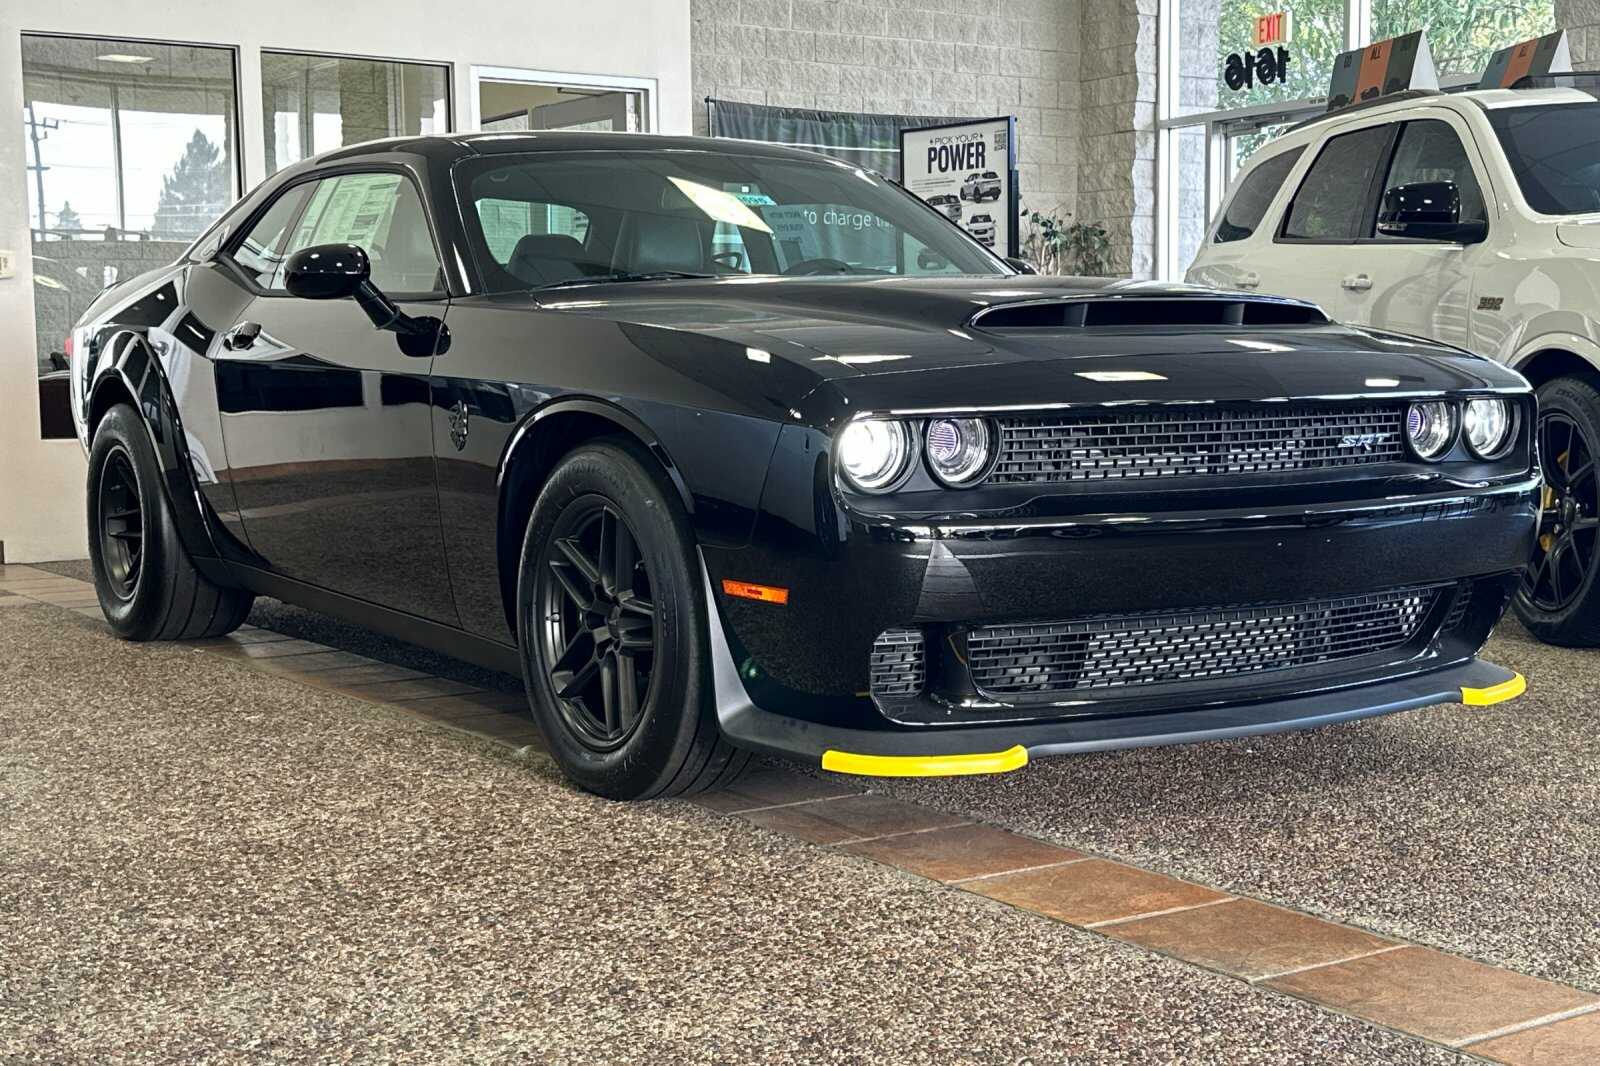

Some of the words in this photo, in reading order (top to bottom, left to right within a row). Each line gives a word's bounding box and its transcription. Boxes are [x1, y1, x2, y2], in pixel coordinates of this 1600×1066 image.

[1259, 14, 1282, 44] EXIT
[934, 136, 953, 146] PICK
[955, 132, 979, 143] YOUR
[927, 141, 986, 174] POWER
[803, 208, 818, 225] to
[823, 207, 872, 231] charge
[1337, 432, 1392, 451] SRT
